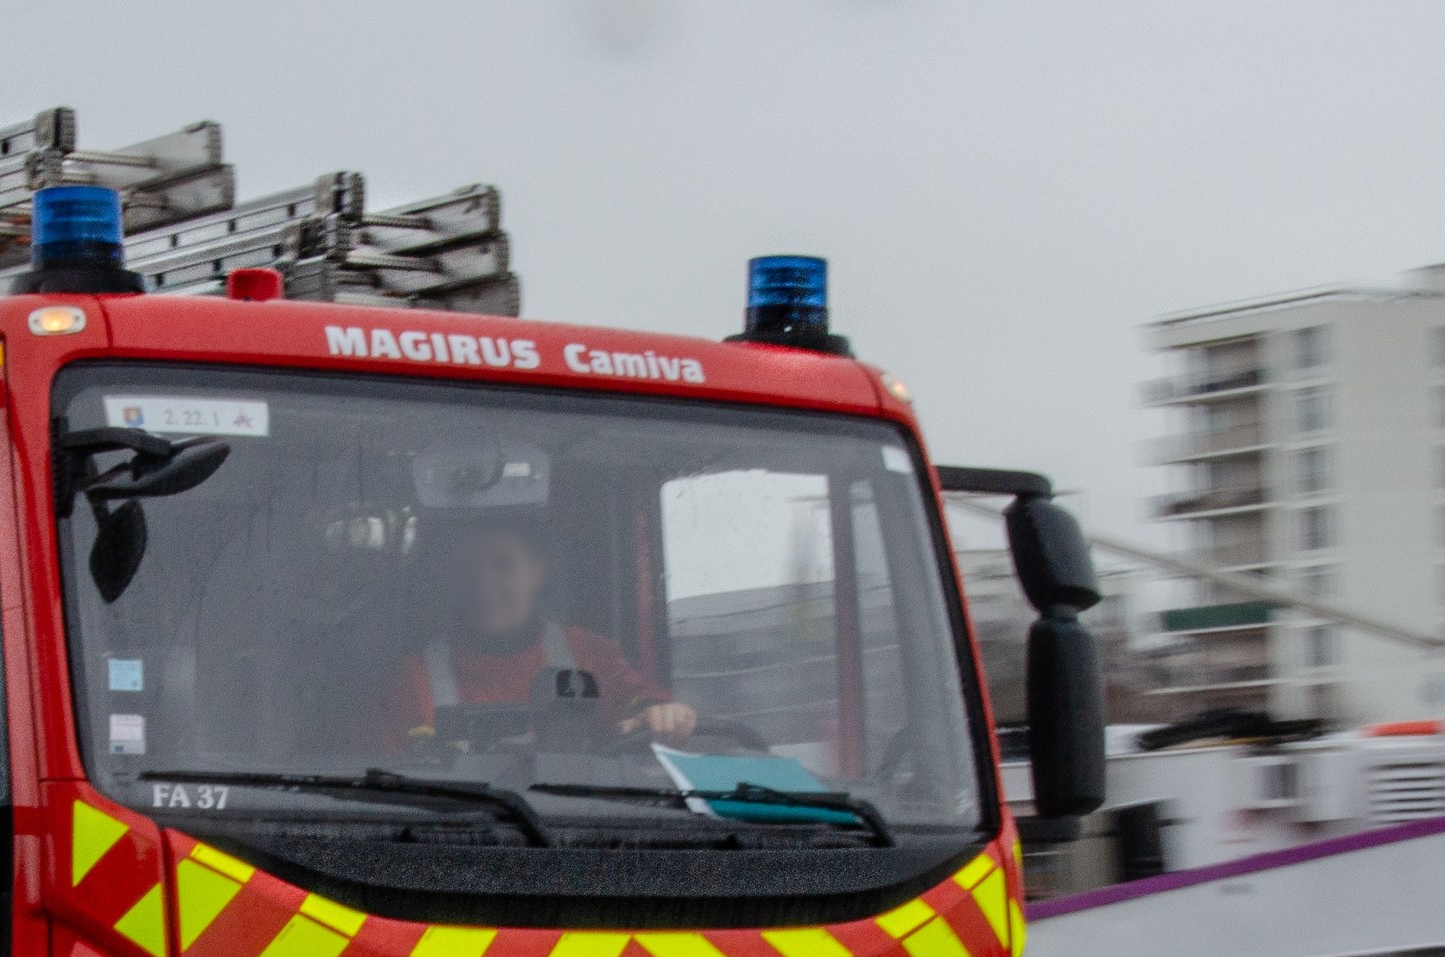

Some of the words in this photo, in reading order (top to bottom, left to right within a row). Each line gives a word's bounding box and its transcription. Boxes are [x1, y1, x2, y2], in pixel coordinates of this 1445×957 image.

[325, 325, 540, 370] MAGIRUS
[563, 343, 705, 384] Camiva
[152, 784, 192, 808] FA
[197, 785, 230, 810] 37
